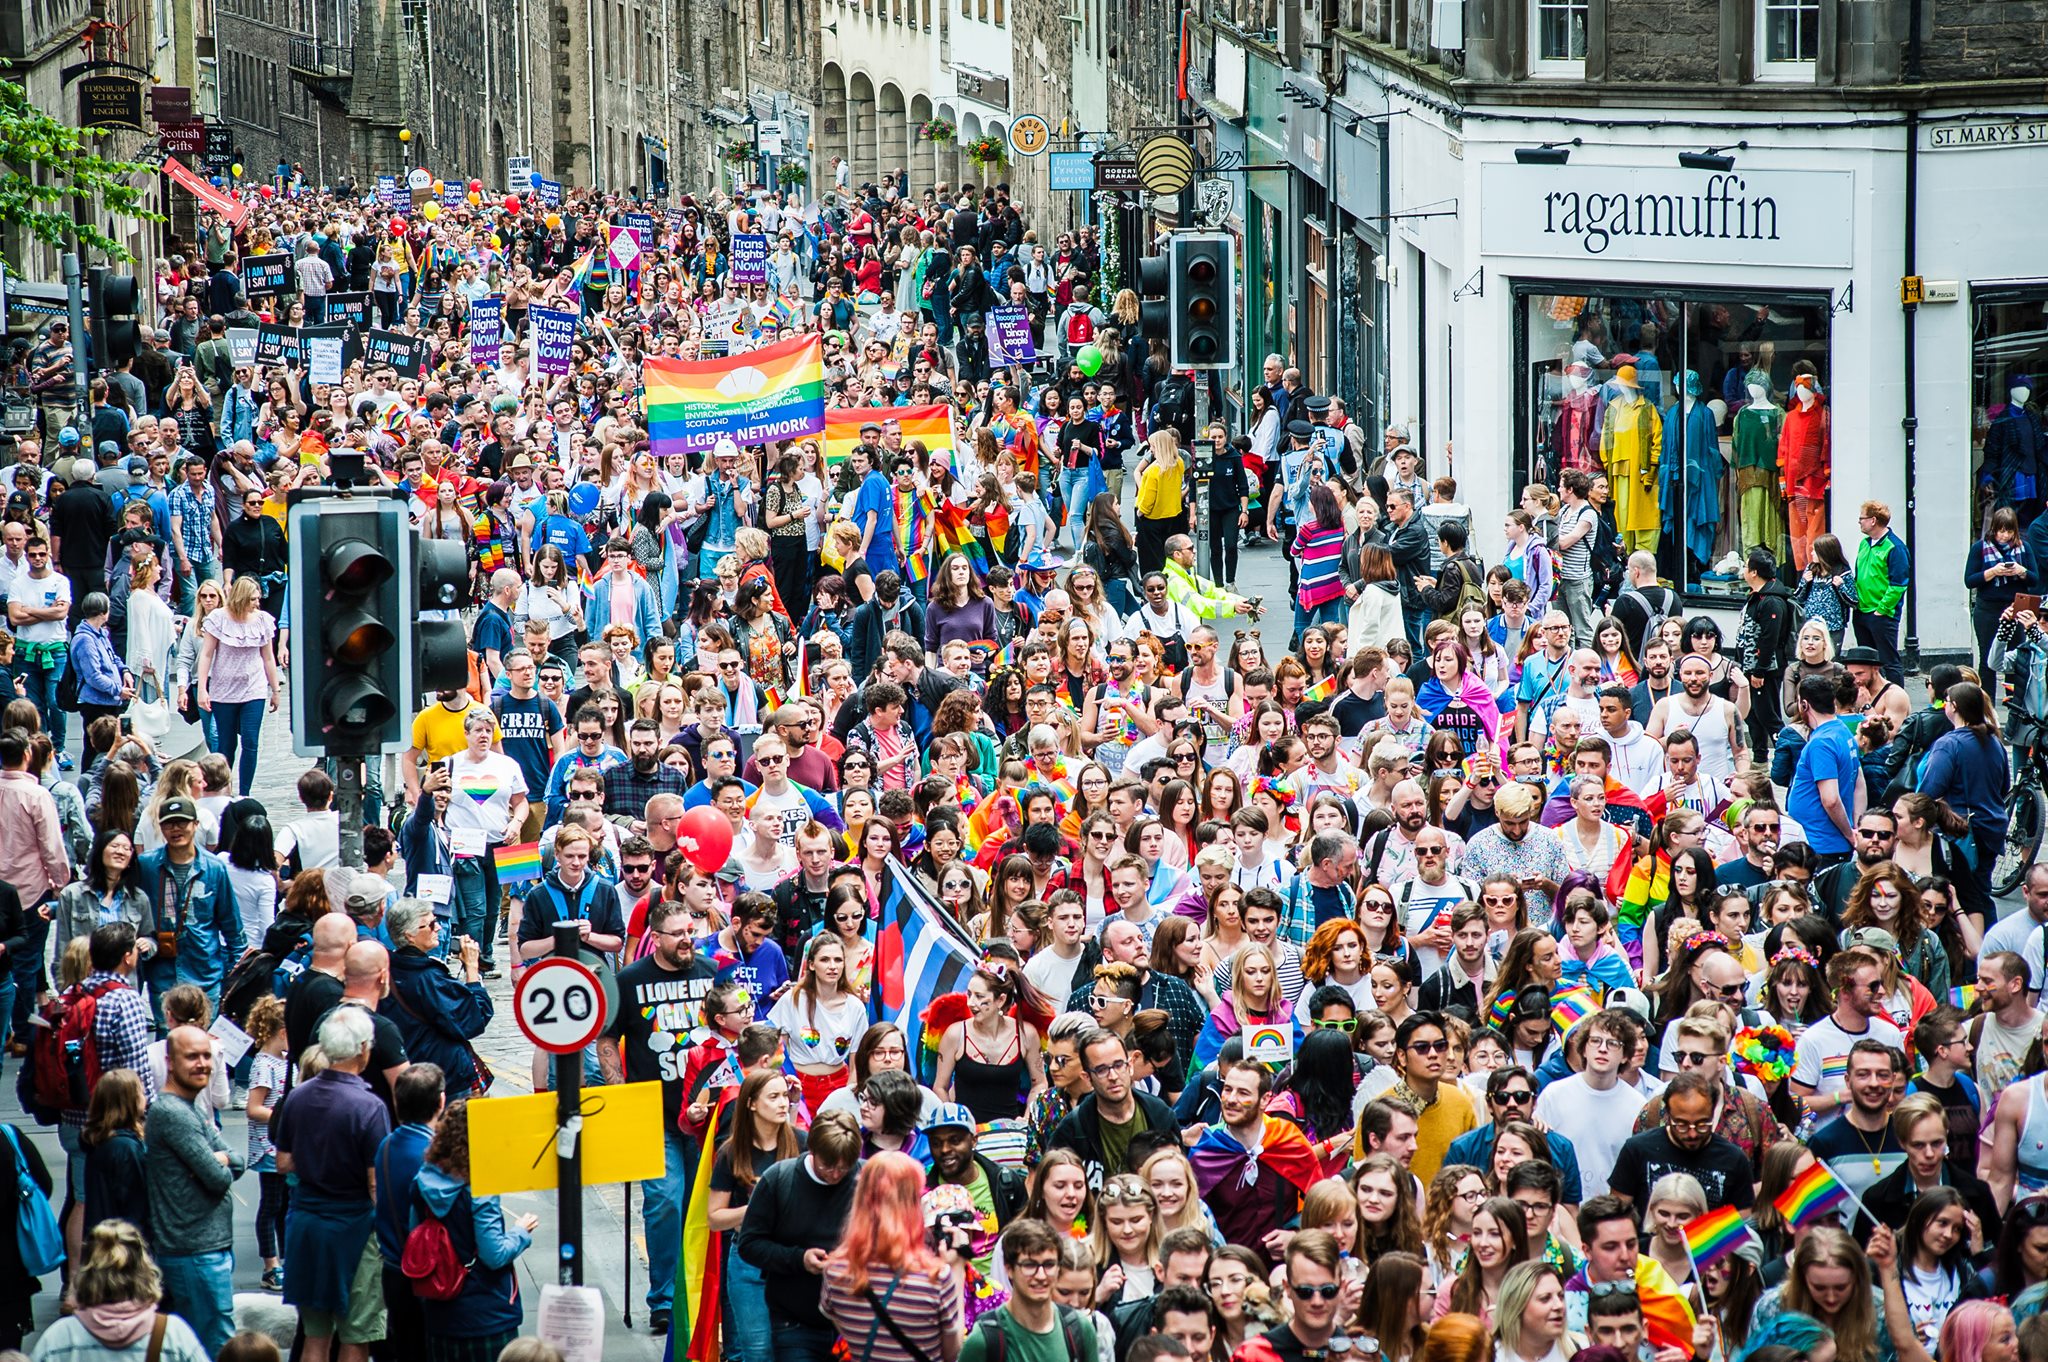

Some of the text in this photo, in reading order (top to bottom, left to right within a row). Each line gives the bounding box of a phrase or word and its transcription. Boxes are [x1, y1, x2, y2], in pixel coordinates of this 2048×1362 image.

[93, 107, 129, 115] ENGLISH
[1015, 120, 1045, 133] SMOOV
[159, 128, 200, 139] Scottish
[1935, 130, 1956, 144] ST.
[1960, 125, 2019, 142] MARY'S
[167, 140, 193, 151] Gifts
[541, 182, 559, 191] Trans
[628, 216, 650, 225] Trans
[1544, 174, 1780, 254] ragamuffin
[735, 239, 764, 249] Trans
[735, 249, 764, 261] Rights
[247, 264, 283, 278] I AM WHO
[735, 260, 764, 271] Now!
[248, 274, 285, 288] I SAY I AM
[329, 301, 363, 313] I AM WHO
[473, 306, 499, 319] Trans
[537, 315, 573, 333] Trans
[995, 313, 1026, 323] Recognise
[473, 318, 499, 334] Rights
[260, 332, 265, 343] I
[265, 333, 280, 345] AM
[472, 330, 499, 347] Now!
[537, 328, 573, 345] Rights
[1005, 328, 1029, 339] binary
[236, 338, 249, 348] AM
[370, 338, 410, 356] I AM WHO
[1003, 337, 1029, 348] people
[237, 347, 252, 358] SAY
[258, 342, 263, 353] I
[264, 343, 280, 356] SAY
[286, 347, 299, 359] AM
[368, 348, 409, 367] I SAY I AM
[684, 403, 719, 411] HISTORIC
[684, 407, 741, 420] ENVIRONMENT
[685, 417, 729, 428] SCOTLAND
[750, 411, 770, 421] ALBA
[686, 416, 810, 448] LGBT+ NETWORK
[1437, 713, 1477, 726] PRIDE
[635, 977, 714, 1004] I LOVE MY
[529, 984, 587, 1025] 20
[656, 1000, 704, 1032] GAY
[709, 1064, 739, 1085] LEAP
